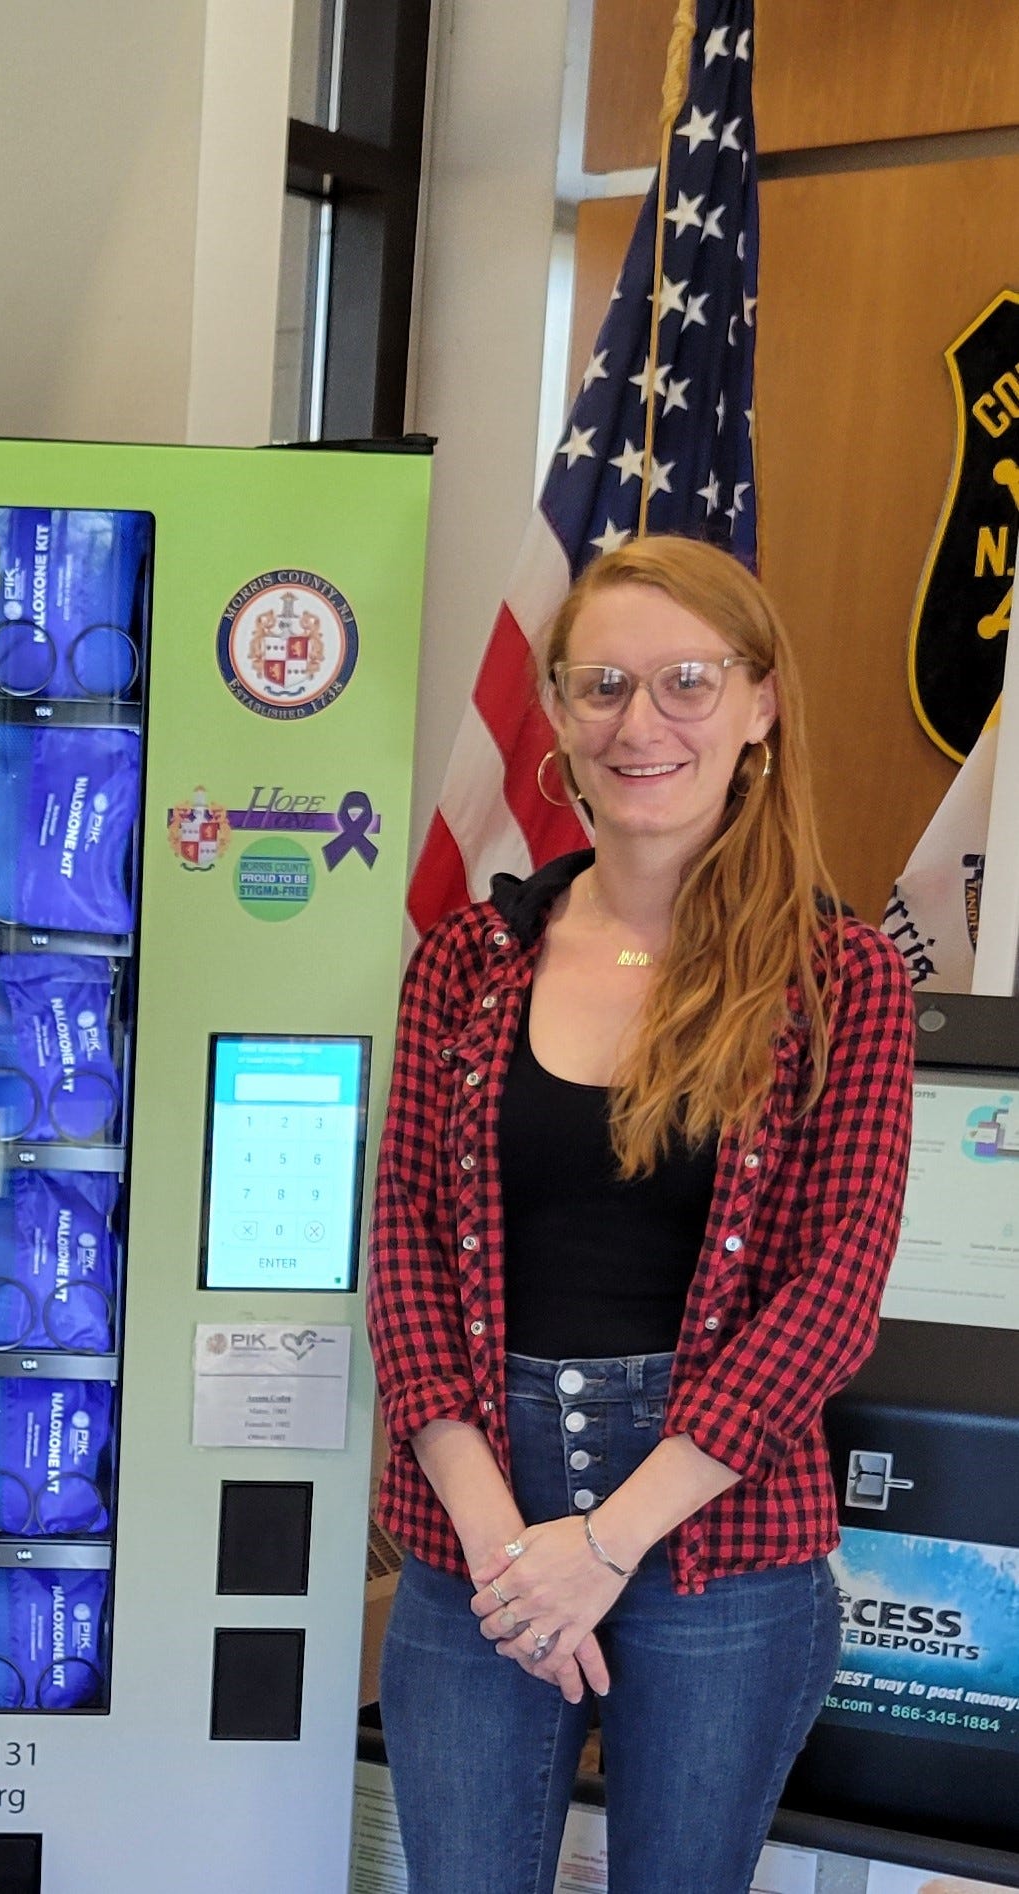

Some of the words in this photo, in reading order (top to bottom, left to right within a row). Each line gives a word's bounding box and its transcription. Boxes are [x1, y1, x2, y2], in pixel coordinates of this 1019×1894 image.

[972, 361, 1019, 438] CO
[36, 524, 50, 552] KIT
[4, 569, 16, 600] PIK
[33, 554, 47, 643] NALOXONE
[224, 573, 273, 621] MORRIS
[228, 678, 306, 719] ESTABLISHED
[311, 681, 344, 712] 1738
[64, 776, 89, 851] NALOXONE
[242, 786, 326, 828] HOPE
[87, 814, 104, 844] PIK
[60, 851, 77, 879] KIT
[240, 862, 272, 872] MORRIS
[274, 862, 309, 873] COUNTY
[241, 873, 275, 883] PROUD
[278, 874, 291, 883] TO
[294, 875, 307, 884] BE
[239, 885, 308, 897] STIGMA-FREE
[32, 936, 49, 945] 114
[883, 884, 939, 987] rris
[50, 998, 75, 1065] NALOXONE
[85, 1027, 101, 1052] PIK
[246, 1116, 252, 1127] 1
[281, 1117, 288, 1128] 2
[315, 1117, 323, 1129] 3
[244, 1152, 251, 1163] 4
[279, 1153, 287, 1165] 5
[313, 1154, 321, 1165] 6
[243, 1188, 250, 1199] 7
[277, 1189, 285, 1200] 8
[311, 1189, 319, 1201] 9
[56, 1209, 72, 1277] NALOXONE
[275, 1225, 283, 1236] 0
[258, 1257, 297, 1269] ENTER
[231, 1333, 266, 1348] PIK
[47, 1392, 64, 1468] NALOXONE
[78, 1429, 90, 1456] PIK
[51, 1585, 65, 1661] NALOXONE
[80, 1622, 91, 1649] PIK
[52, 1664, 66, 1688] KIT
[874, 1677, 908, 1695] way
[908, 1681, 925, 1696] to
[926, 1685, 964, 1701] post
[822, 1694, 873, 1713] ts.com
[891, 1704, 1001, 1732] 866-345-1884
